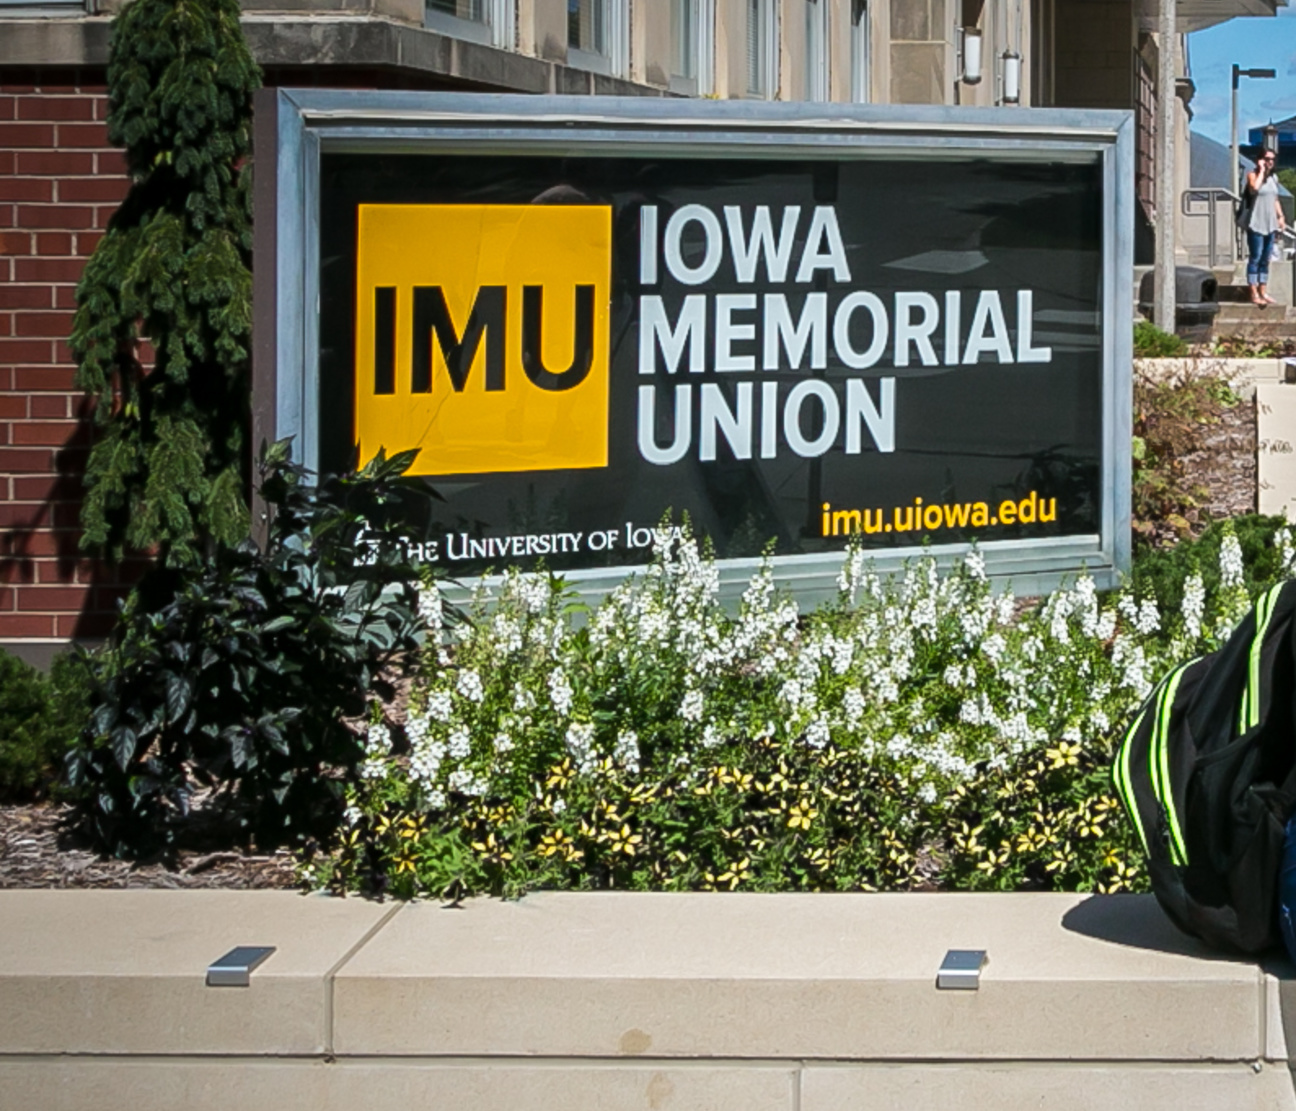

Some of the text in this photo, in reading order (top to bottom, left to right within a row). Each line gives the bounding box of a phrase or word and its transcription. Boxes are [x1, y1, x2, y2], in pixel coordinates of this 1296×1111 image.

[639, 203, 852, 285] IOWA
[373, 283, 596, 395] IMU
[637, 288, 1052, 374] MEMORIAL
[637, 376, 897, 466] UNION
[821, 489, 1057, 537] imu.uiowa.edu
